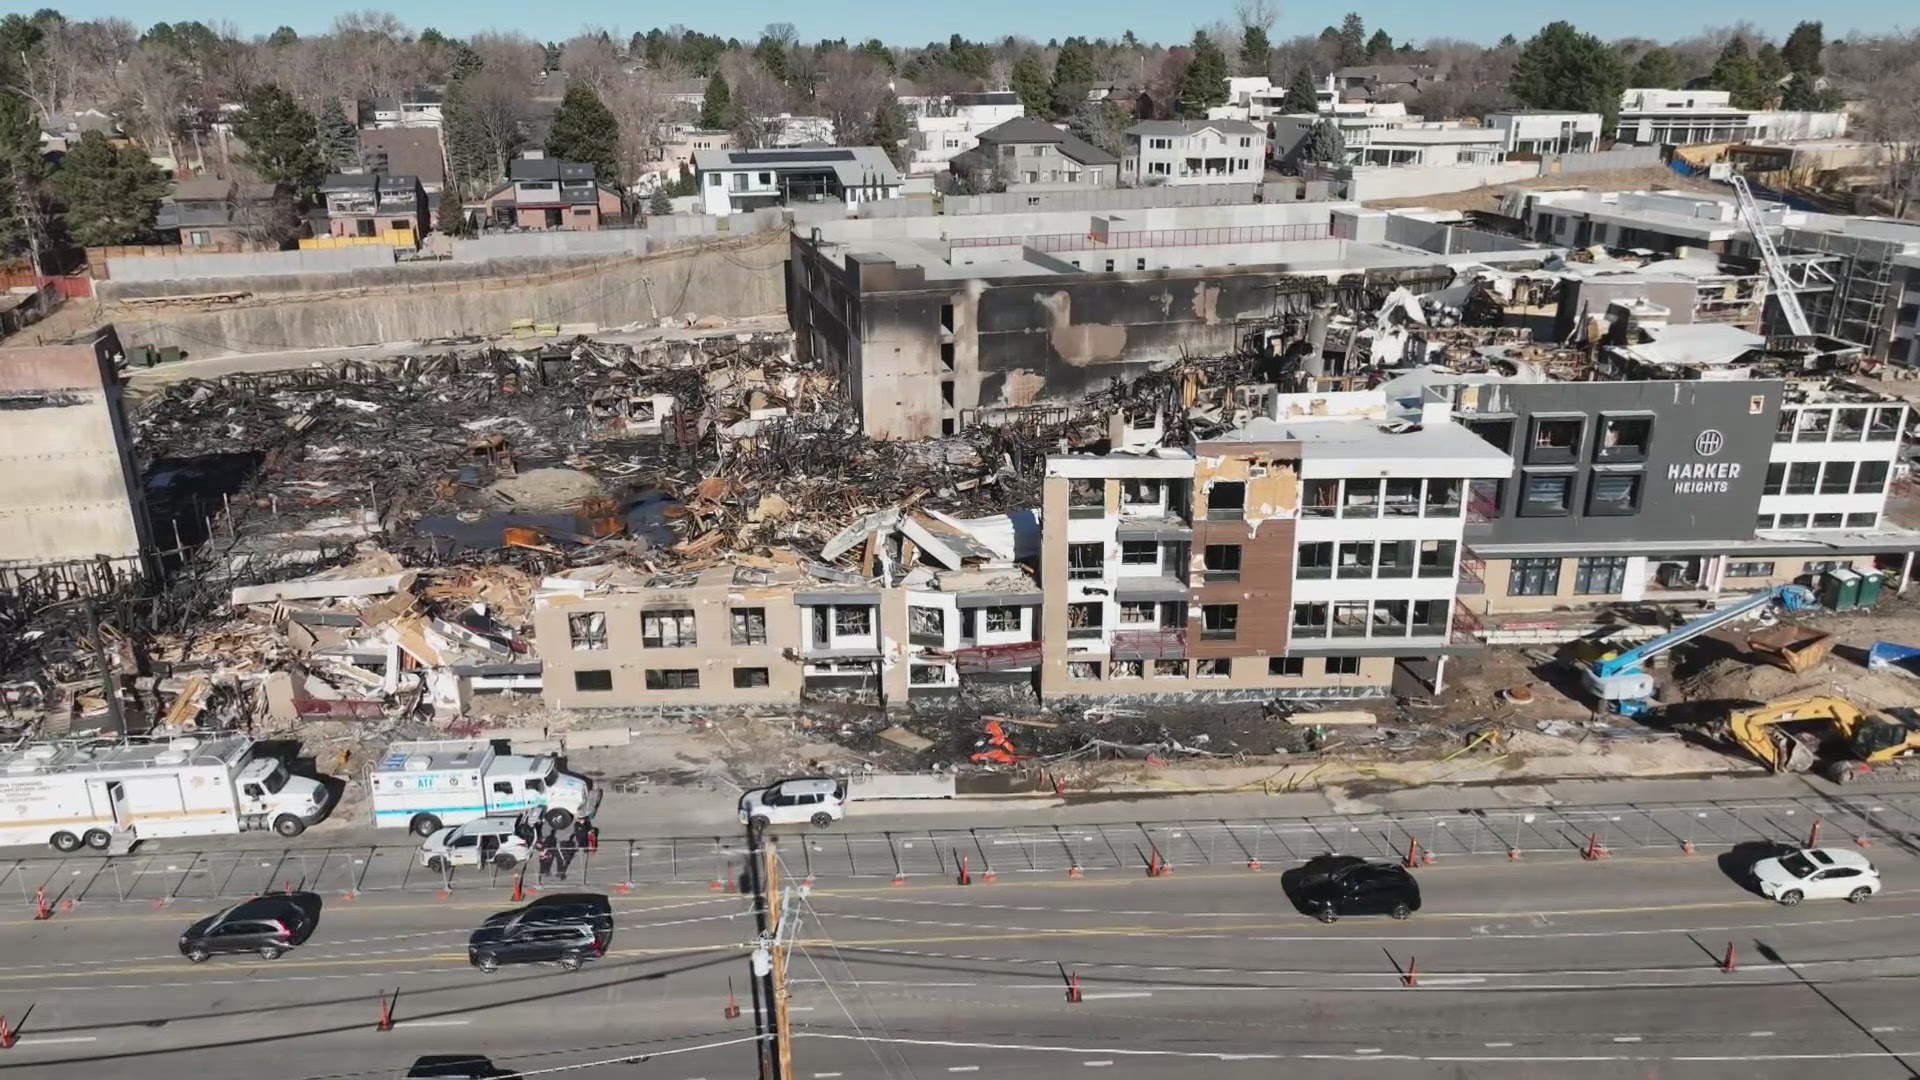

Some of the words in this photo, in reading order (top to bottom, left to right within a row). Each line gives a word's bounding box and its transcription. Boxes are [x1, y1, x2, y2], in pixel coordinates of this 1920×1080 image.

[1667, 463, 1741, 480] HARKER
[1674, 481, 1729, 494] HEIGHTS
[417, 778, 433, 789] ATF
